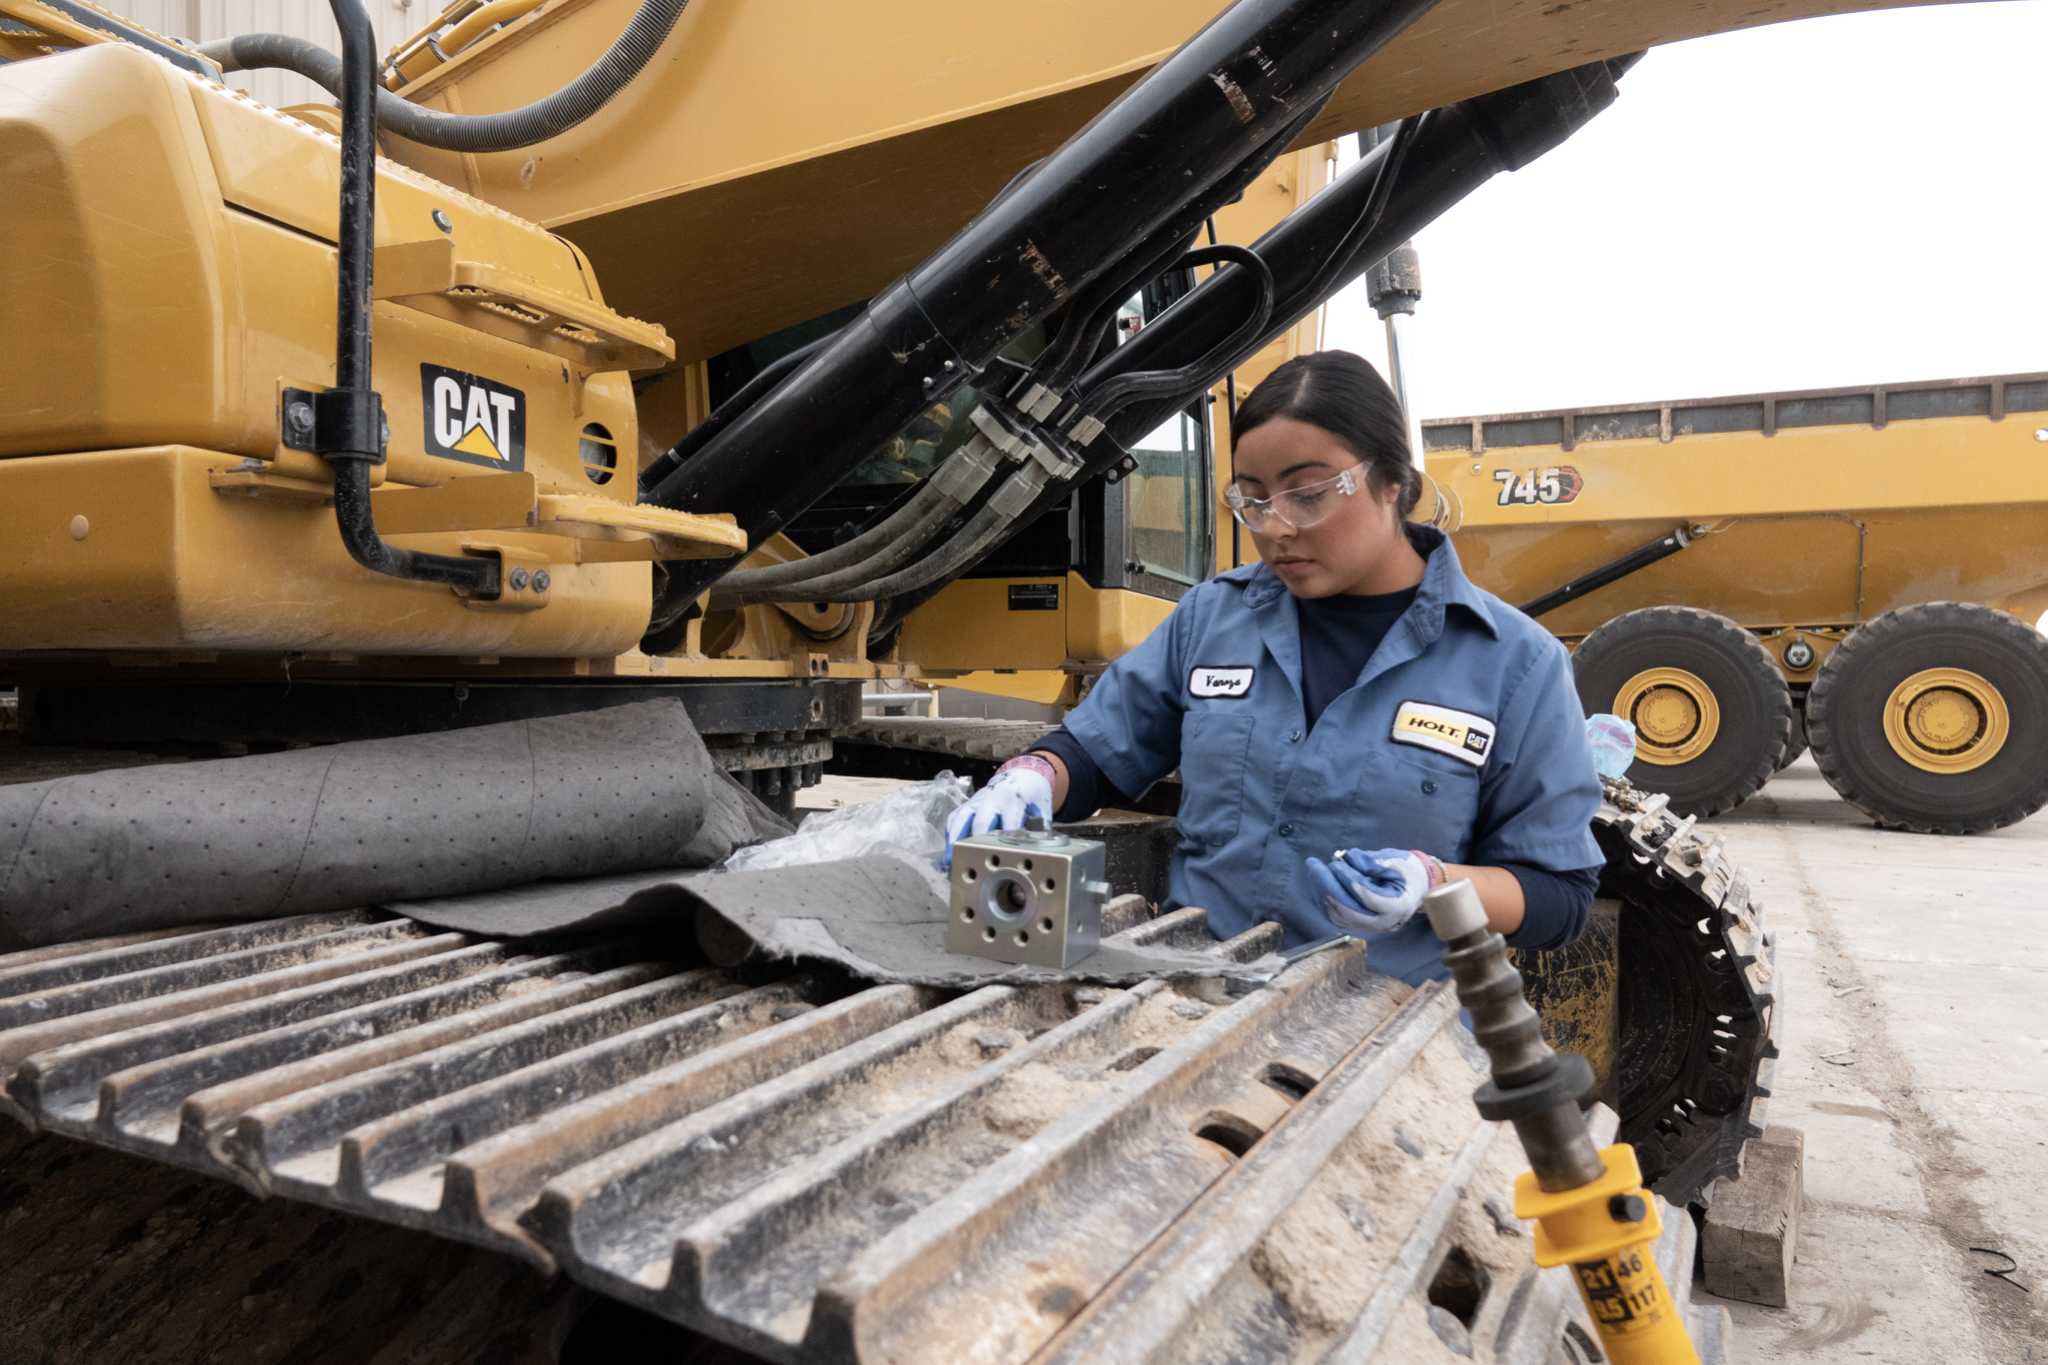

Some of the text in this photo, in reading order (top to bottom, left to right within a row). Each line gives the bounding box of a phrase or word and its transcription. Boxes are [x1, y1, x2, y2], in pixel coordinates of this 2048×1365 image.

[433, 376, 516, 461] CAT
[1494, 467, 1560, 505] 745
[1466, 732, 1488, 750] CAT
[1618, 1253, 1643, 1278] 46
[1630, 1284, 1657, 1311] 117
